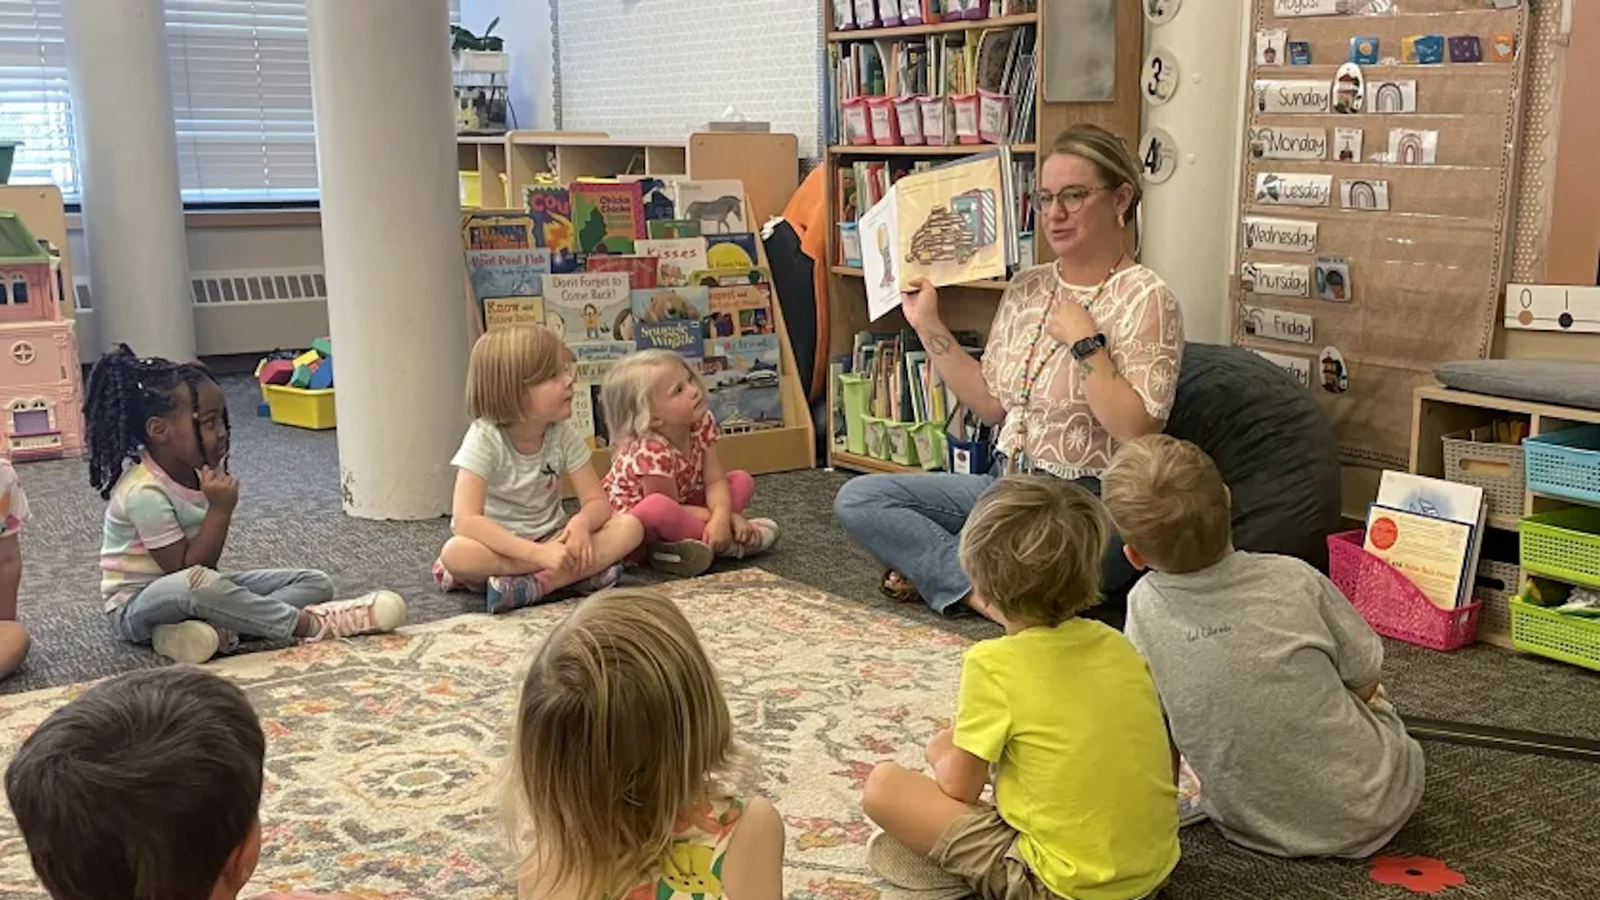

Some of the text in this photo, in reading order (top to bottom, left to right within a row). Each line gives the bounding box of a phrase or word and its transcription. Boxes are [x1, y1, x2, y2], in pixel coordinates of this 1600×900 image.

[1148, 57, 1162, 96] 3
[1279, 87, 1329, 110] Sunday
[1144, 137, 1157, 175] 4
[1270, 132, 1325, 157] Monday
[1278, 178, 1329, 205] Tuesday
[1246, 223, 1315, 252] Wednesday
[647, 248, 697, 260] Kisses
[553, 276, 622, 288] Don't Forget to
[561, 288, 616, 300] Come Back!
[1254, 268, 1307, 296] Thursday
[487, 302, 519, 313] Know
[640, 323, 688, 338] Snuggle
[1273, 315, 1311, 341] Friday
